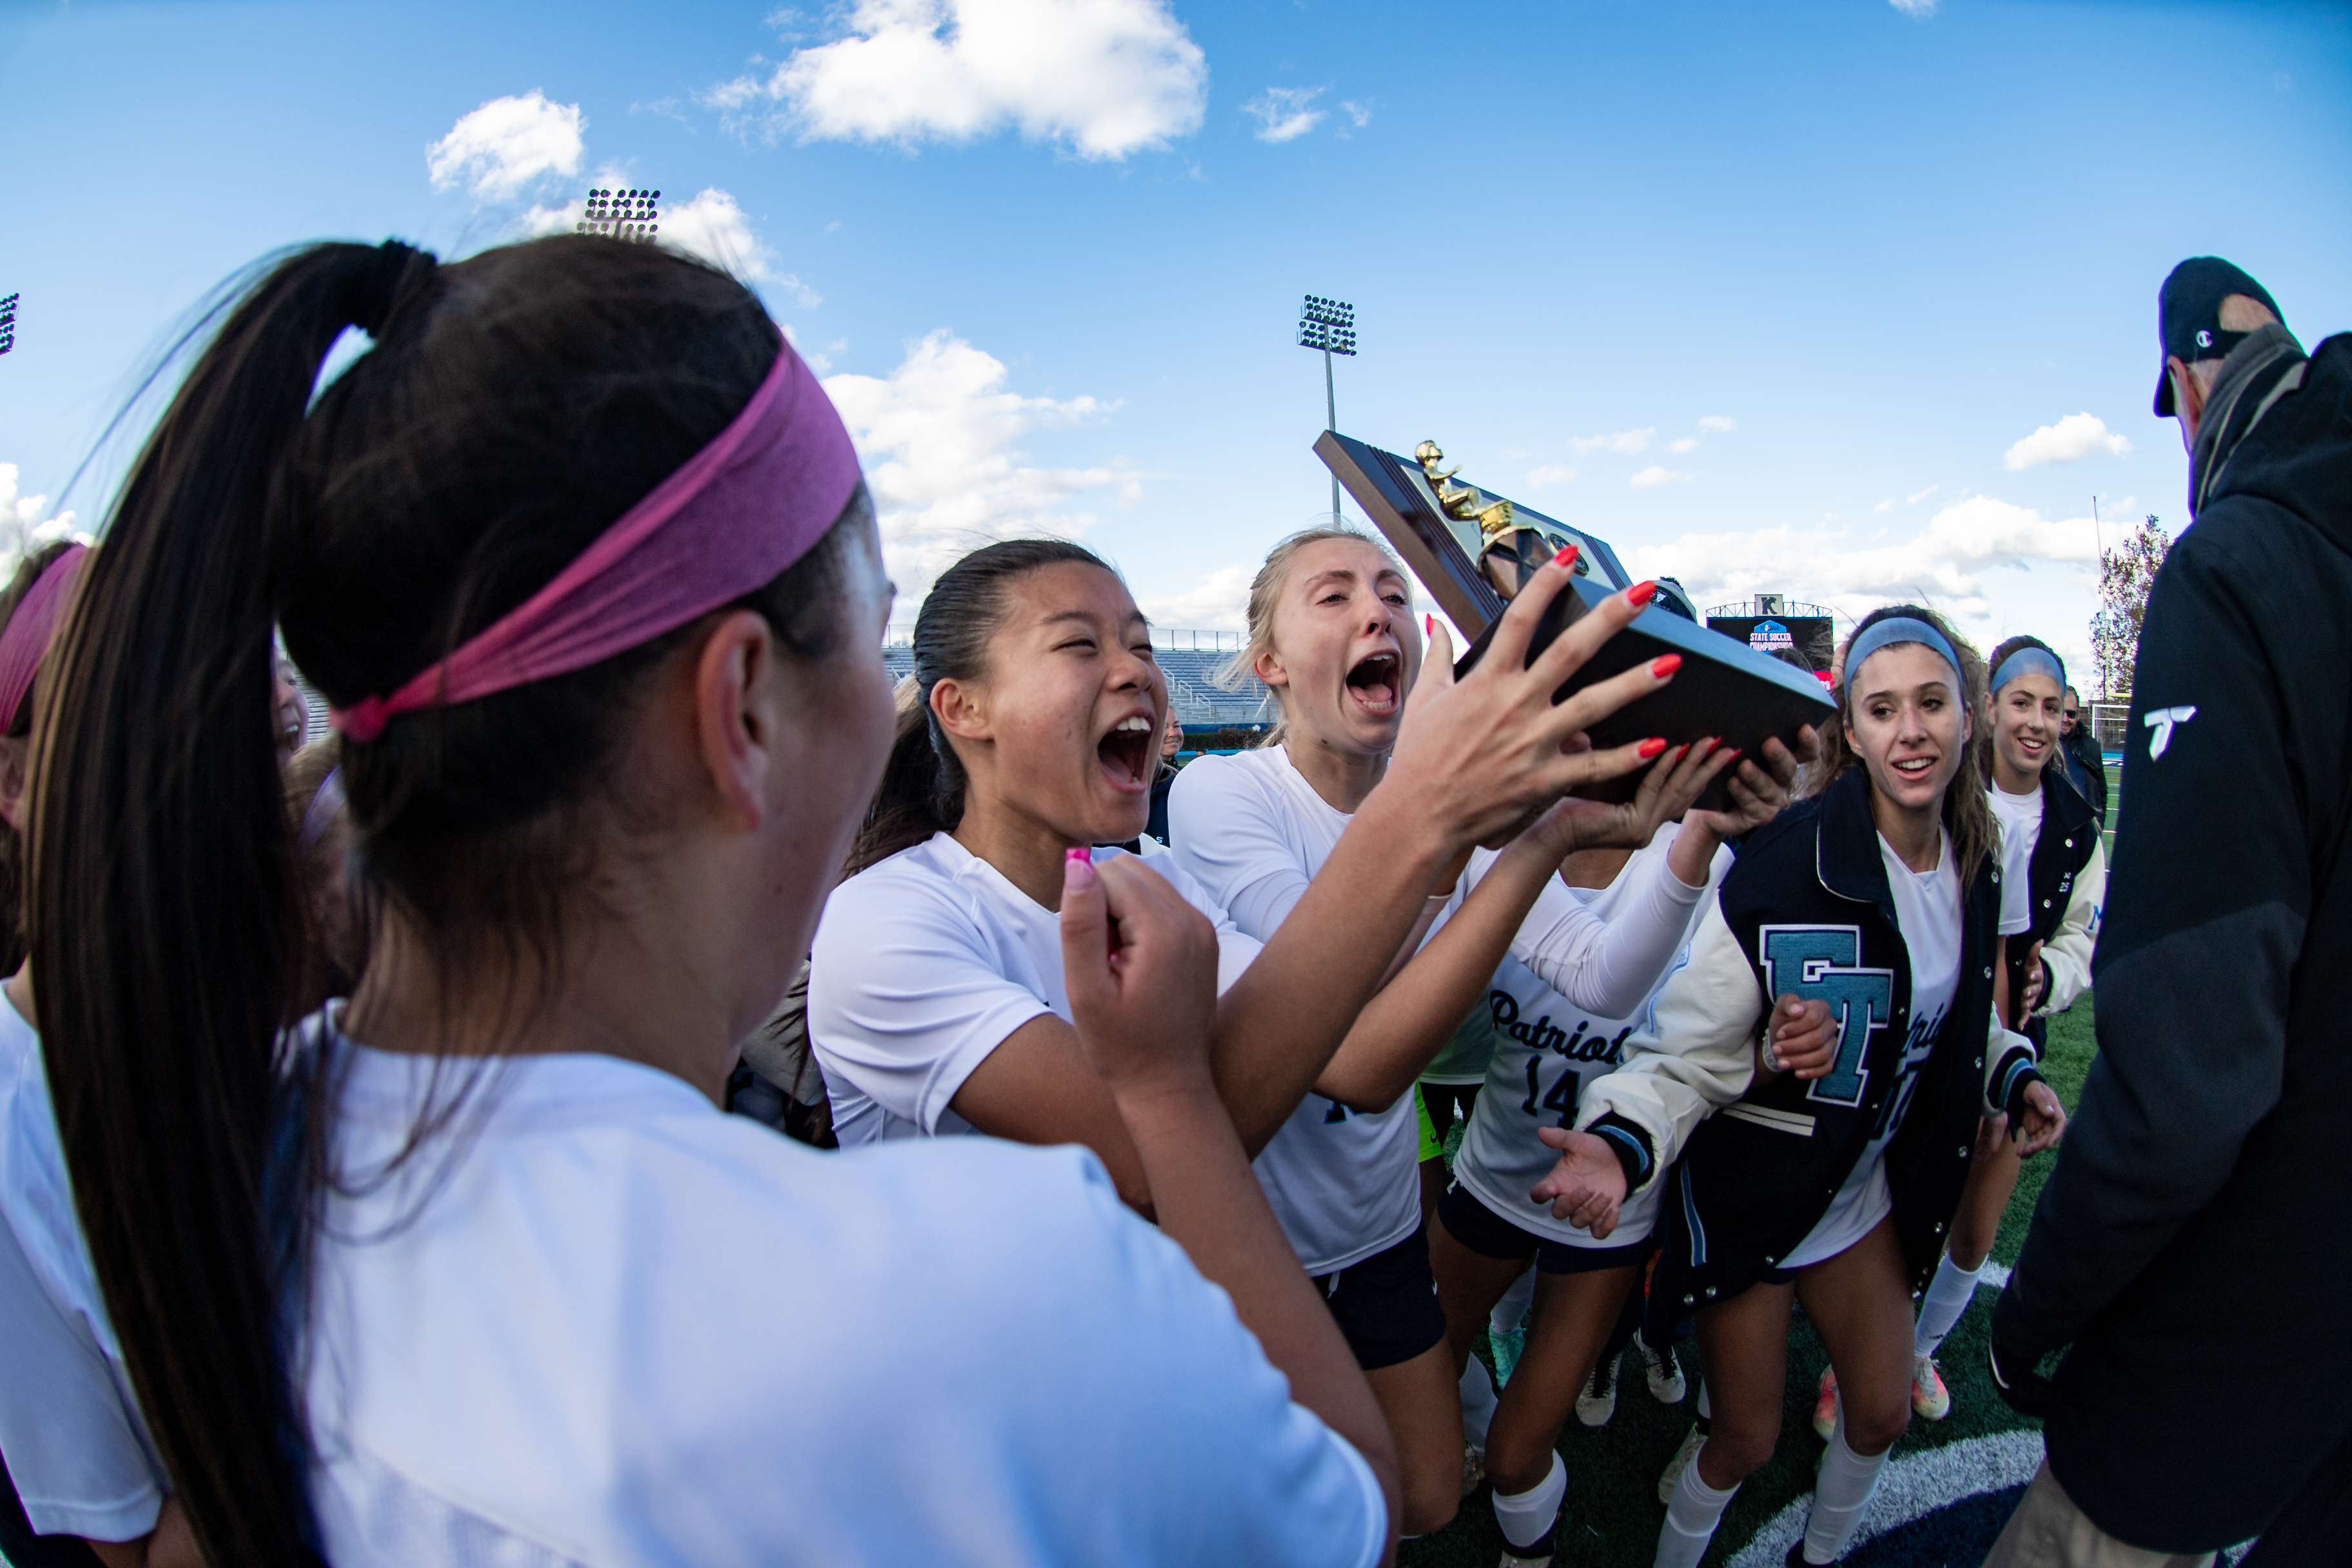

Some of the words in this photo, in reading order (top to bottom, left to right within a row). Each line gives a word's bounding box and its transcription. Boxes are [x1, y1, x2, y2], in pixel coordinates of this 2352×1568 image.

[1750, 632, 1768, 642] STATE
[1769, 632, 1792, 642] SOCCER
[1489, 990, 1632, 1064] Patriot
[1522, 1054, 1582, 1130] 14
